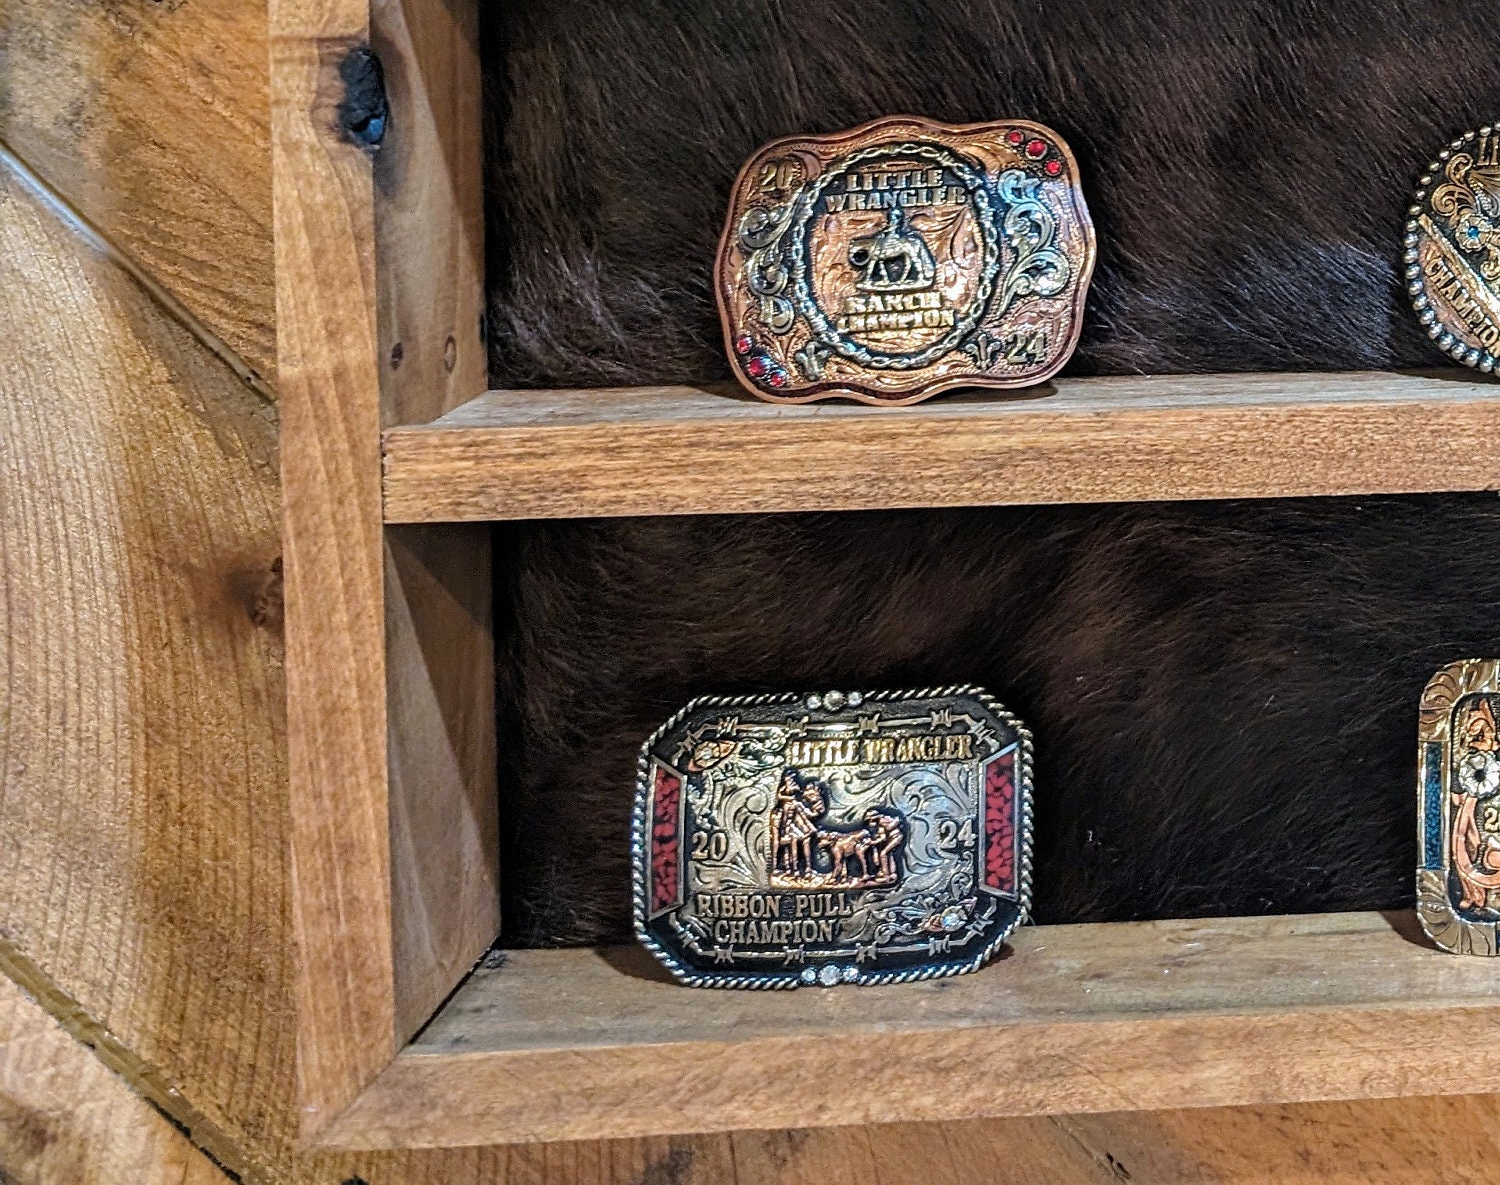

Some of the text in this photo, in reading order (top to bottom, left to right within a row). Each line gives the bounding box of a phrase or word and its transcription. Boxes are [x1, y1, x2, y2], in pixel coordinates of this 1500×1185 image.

[760, 161, 794, 192] 20
[846, 169, 943, 192] LITTLE
[825, 186, 967, 213] WRANGLER
[845, 290, 942, 315] RANCH
[836, 309, 955, 334] CHAMPION
[1006, 333, 1047, 364] 24
[790, 734, 973, 766] LITTLE WRANGLER
[692, 832, 728, 859] 20
[939, 820, 975, 848] 24
[698, 892, 852, 920] RIBBON PULL
[714, 920, 838, 945] CHAMPION
